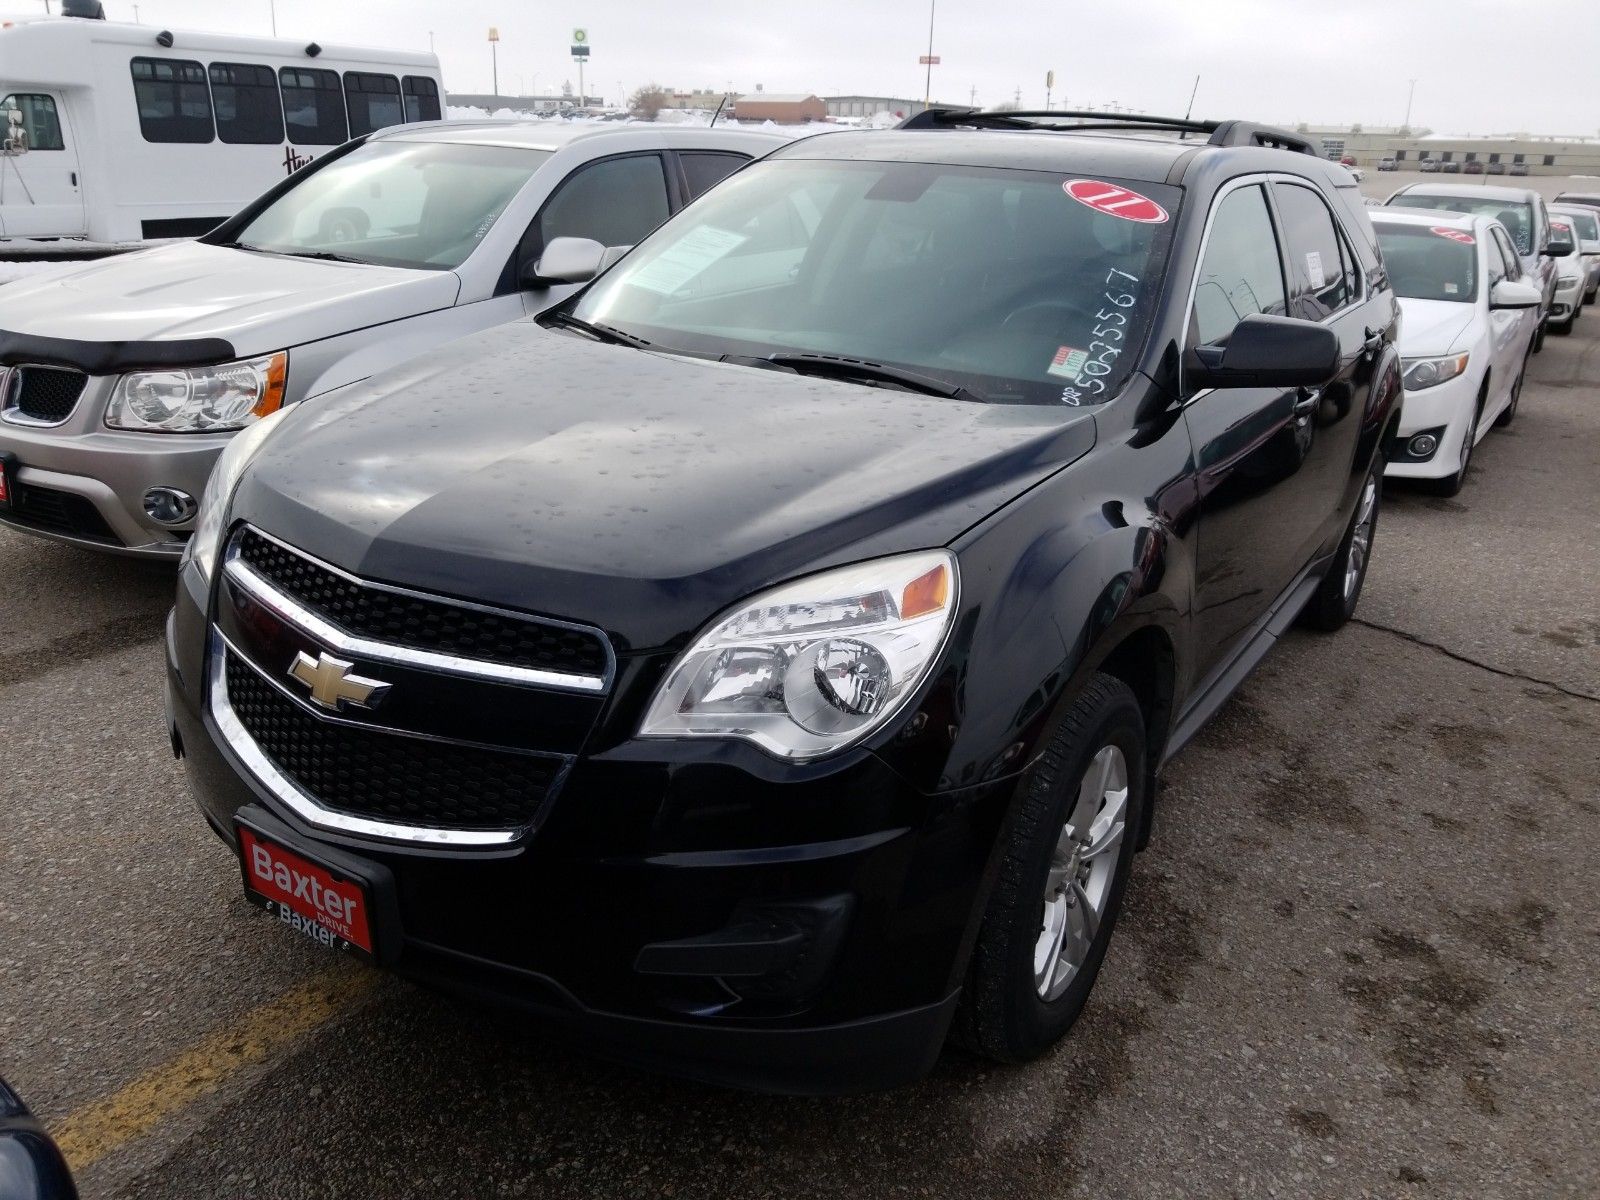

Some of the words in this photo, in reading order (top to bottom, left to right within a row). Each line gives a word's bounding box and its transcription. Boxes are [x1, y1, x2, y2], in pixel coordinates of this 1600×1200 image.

[1078, 188, 1148, 212] 11
[1074, 267, 1139, 394] 5025567
[251, 843, 357, 926] Baxter
[279, 902, 338, 948] Baxter
